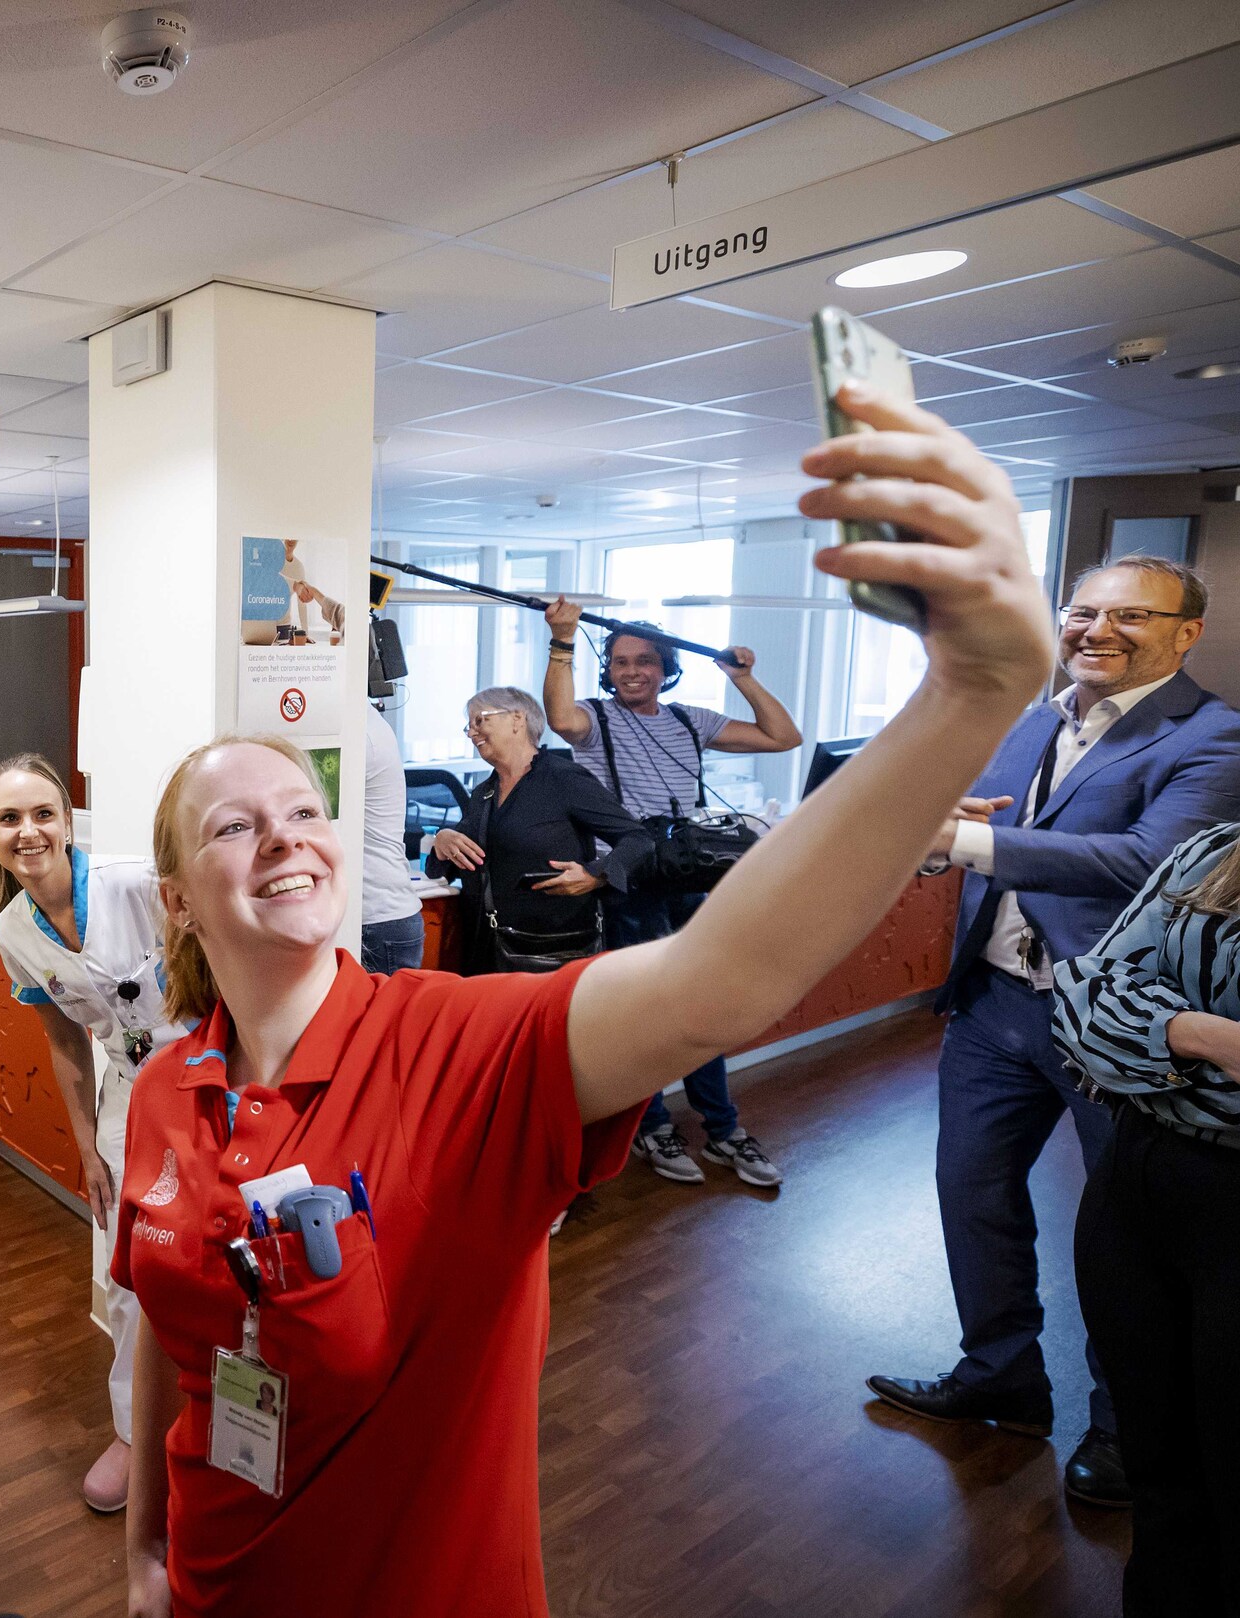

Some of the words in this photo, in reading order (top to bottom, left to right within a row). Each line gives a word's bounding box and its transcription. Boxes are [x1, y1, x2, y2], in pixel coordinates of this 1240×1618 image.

[654, 226, 768, 275] Uitgang
[247, 593, 286, 605] Coronavirus
[268, 653, 275, 661] de
[270, 664, 279, 672] het
